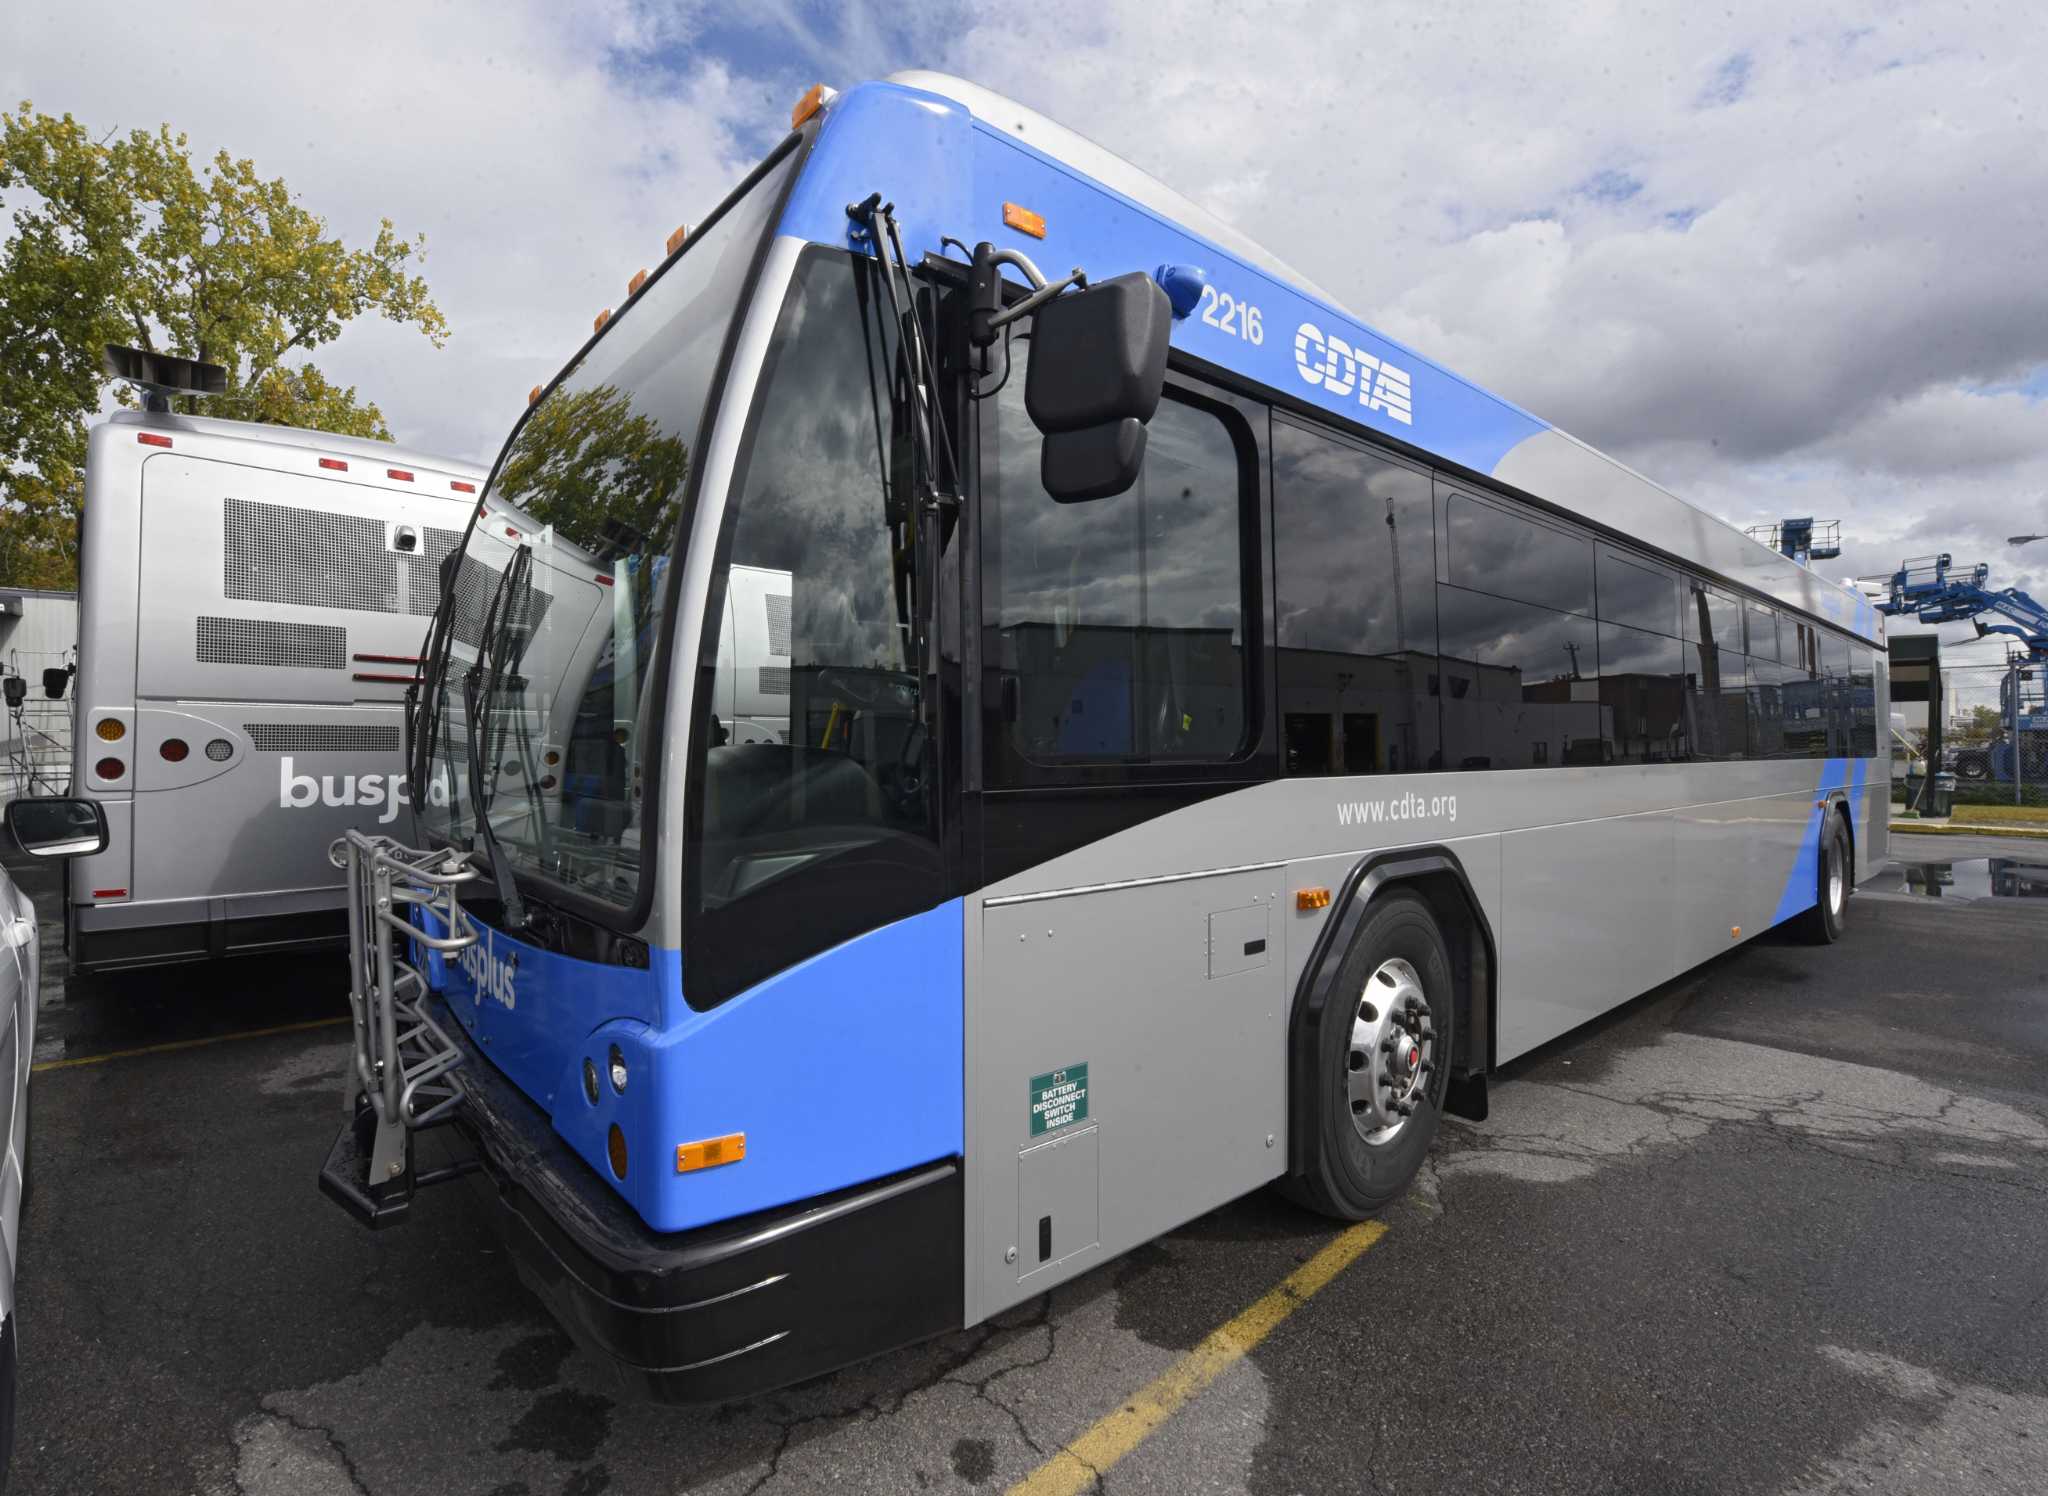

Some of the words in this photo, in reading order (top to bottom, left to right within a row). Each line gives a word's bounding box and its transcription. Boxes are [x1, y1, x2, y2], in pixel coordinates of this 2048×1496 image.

[1201, 284, 1264, 346] 2216
[1295, 322, 1413, 426] CDTA
[280, 756, 412, 824] busp
[1336, 791, 1457, 825] www.cdta.org
[458, 928, 516, 1010] usplus
[1033, 1088, 1086, 1114] DISCONNECT
[1042, 1082, 1077, 1100] BATTERY
[1044, 1102, 1075, 1119] SWITCH
[1046, 1112, 1074, 1129] INSIDE
